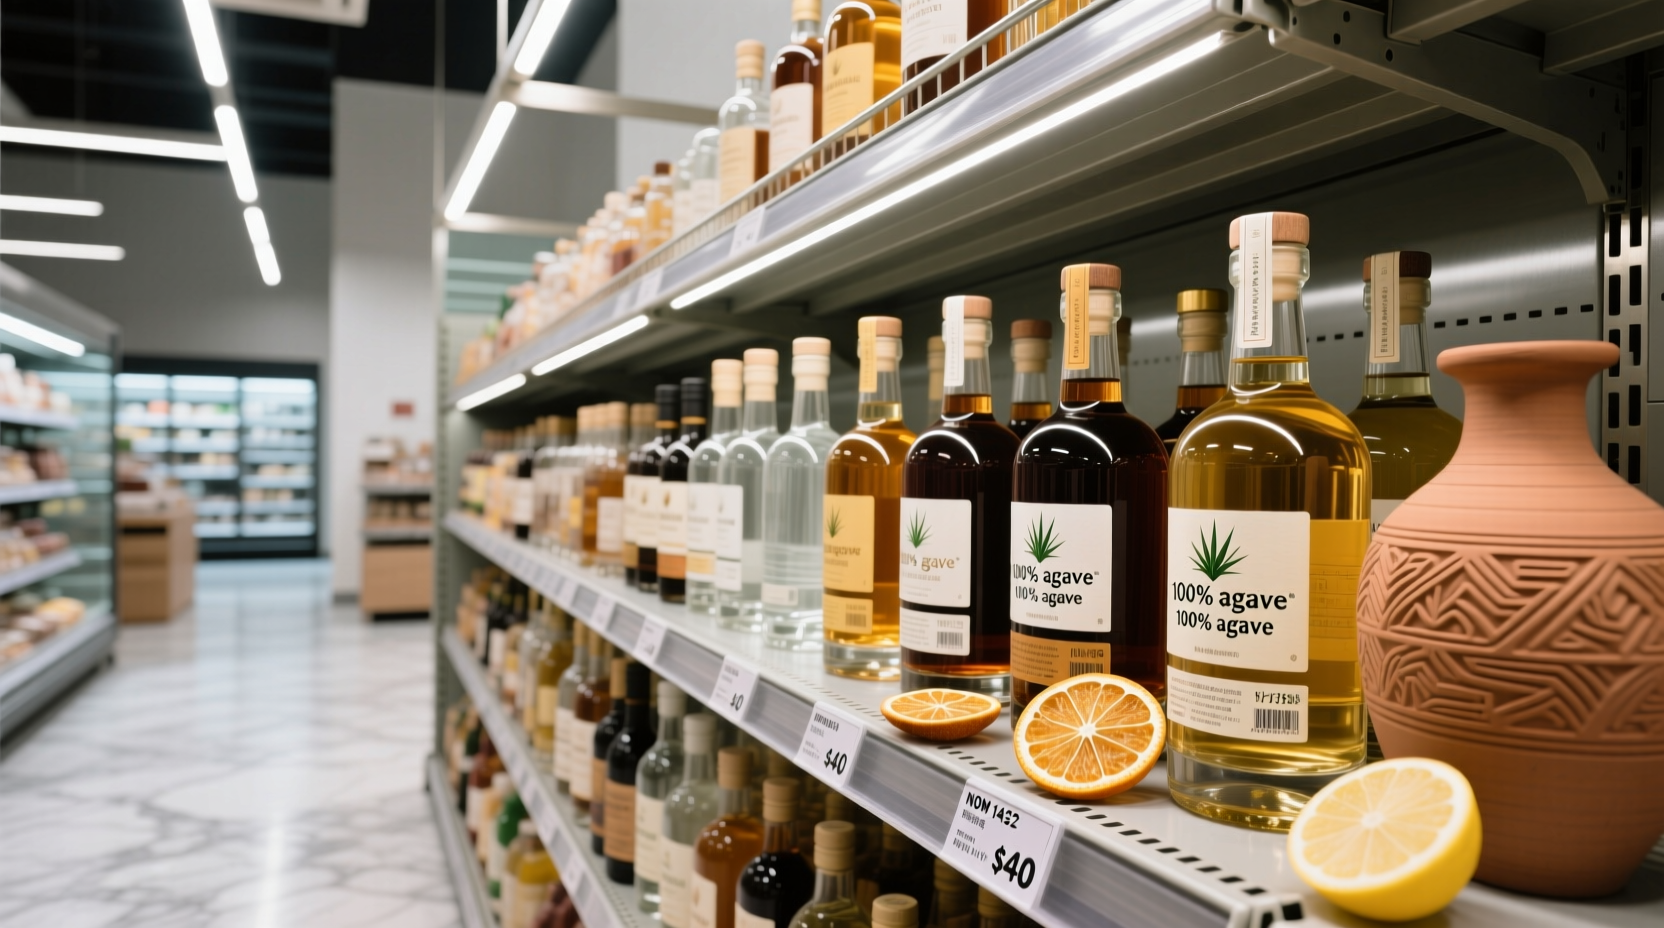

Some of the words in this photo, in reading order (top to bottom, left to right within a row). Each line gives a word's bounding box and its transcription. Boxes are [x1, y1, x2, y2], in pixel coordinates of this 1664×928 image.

[1043, 570, 1094, 589] agave
[1041, 592, 1083, 608] agave
[1172, 581, 1214, 606] 100%
[1219, 591, 1288, 614] agave
[1176, 609, 1212, 631] 100%
[1216, 616, 1274, 639] agave
[823, 748, 848, 775] $40
[991, 845, 1036, 889] $40
